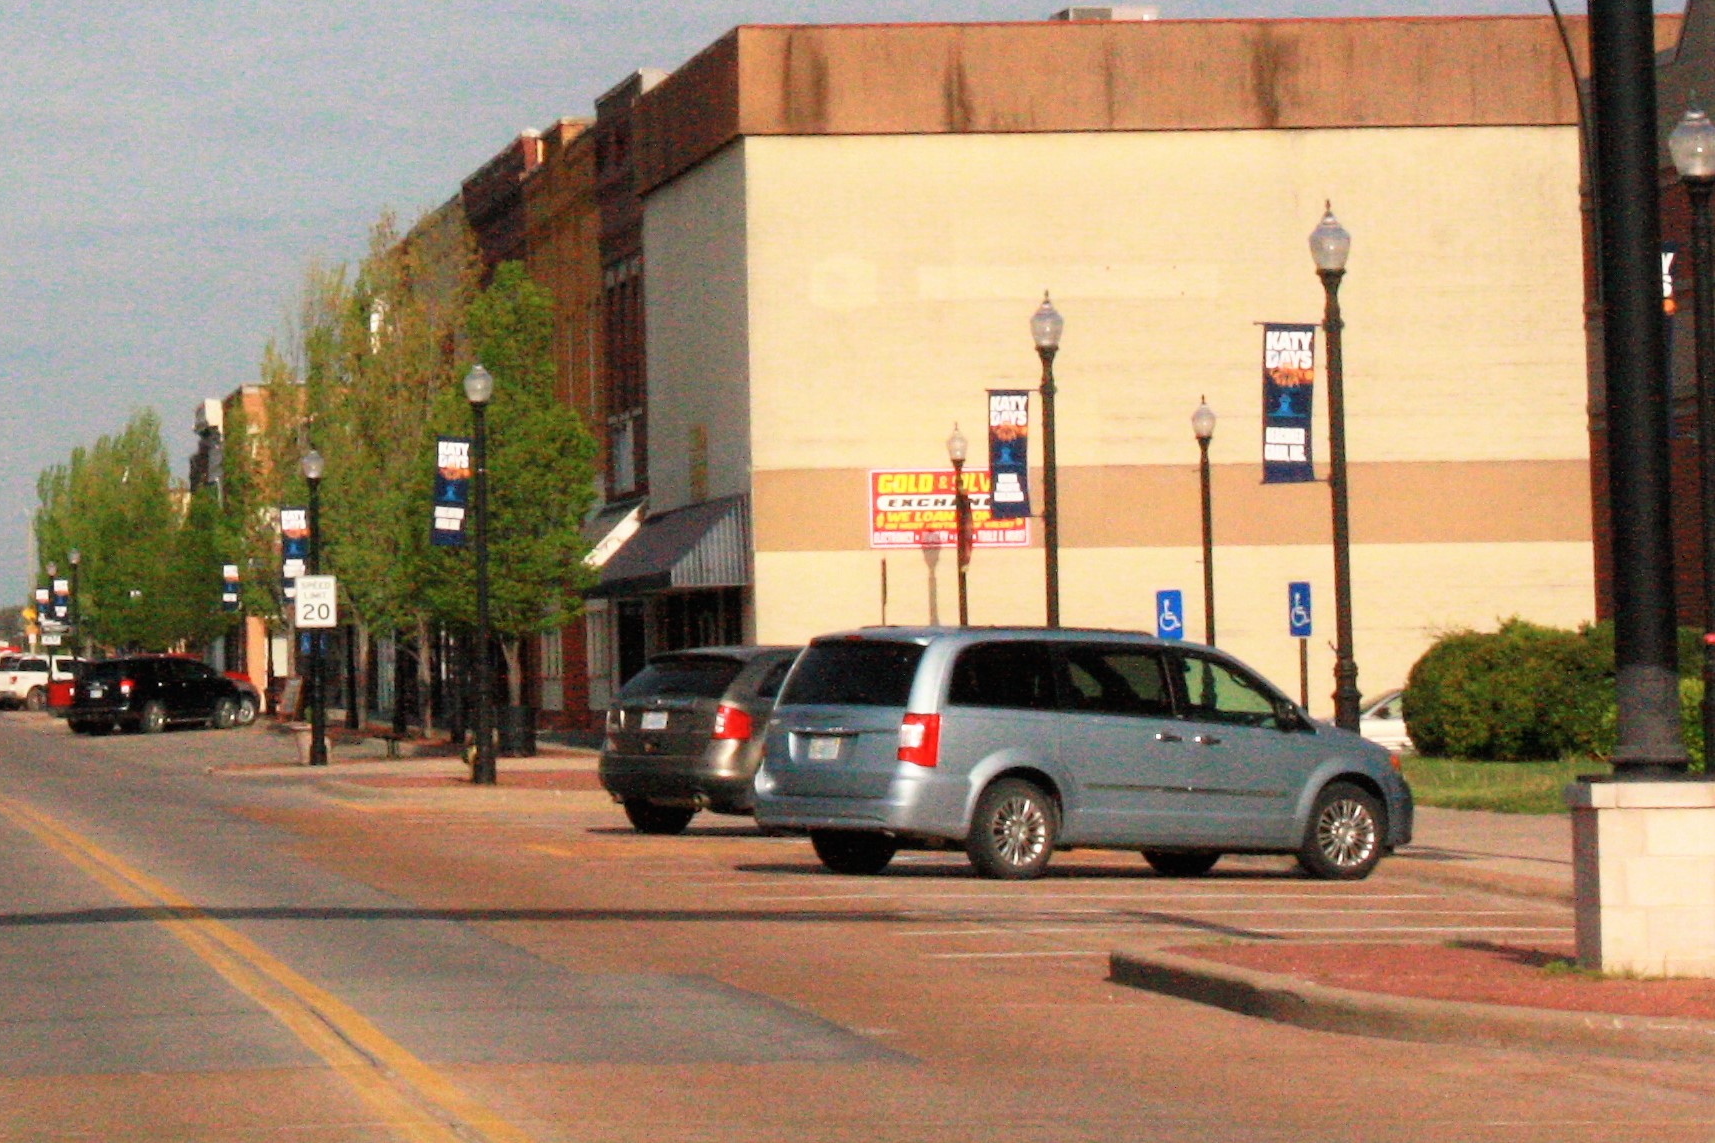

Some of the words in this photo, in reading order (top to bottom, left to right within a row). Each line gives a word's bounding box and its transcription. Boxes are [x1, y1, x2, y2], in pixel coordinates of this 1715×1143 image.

[1265, 331, 1313, 351] KATY
[1266, 350, 1313, 369] DAYS
[990, 396, 1028, 411] KATY
[990, 410, 1027, 426] DAYS
[438, 441, 469, 456] KATY
[878, 474, 934, 494] GOLD
[938, 476, 948, 489] &
[888, 498, 991, 507] EXCHN
[301, 581, 331, 589] SPEED
[304, 591, 326, 599] LIMIT
[303, 603, 330, 620] 20
